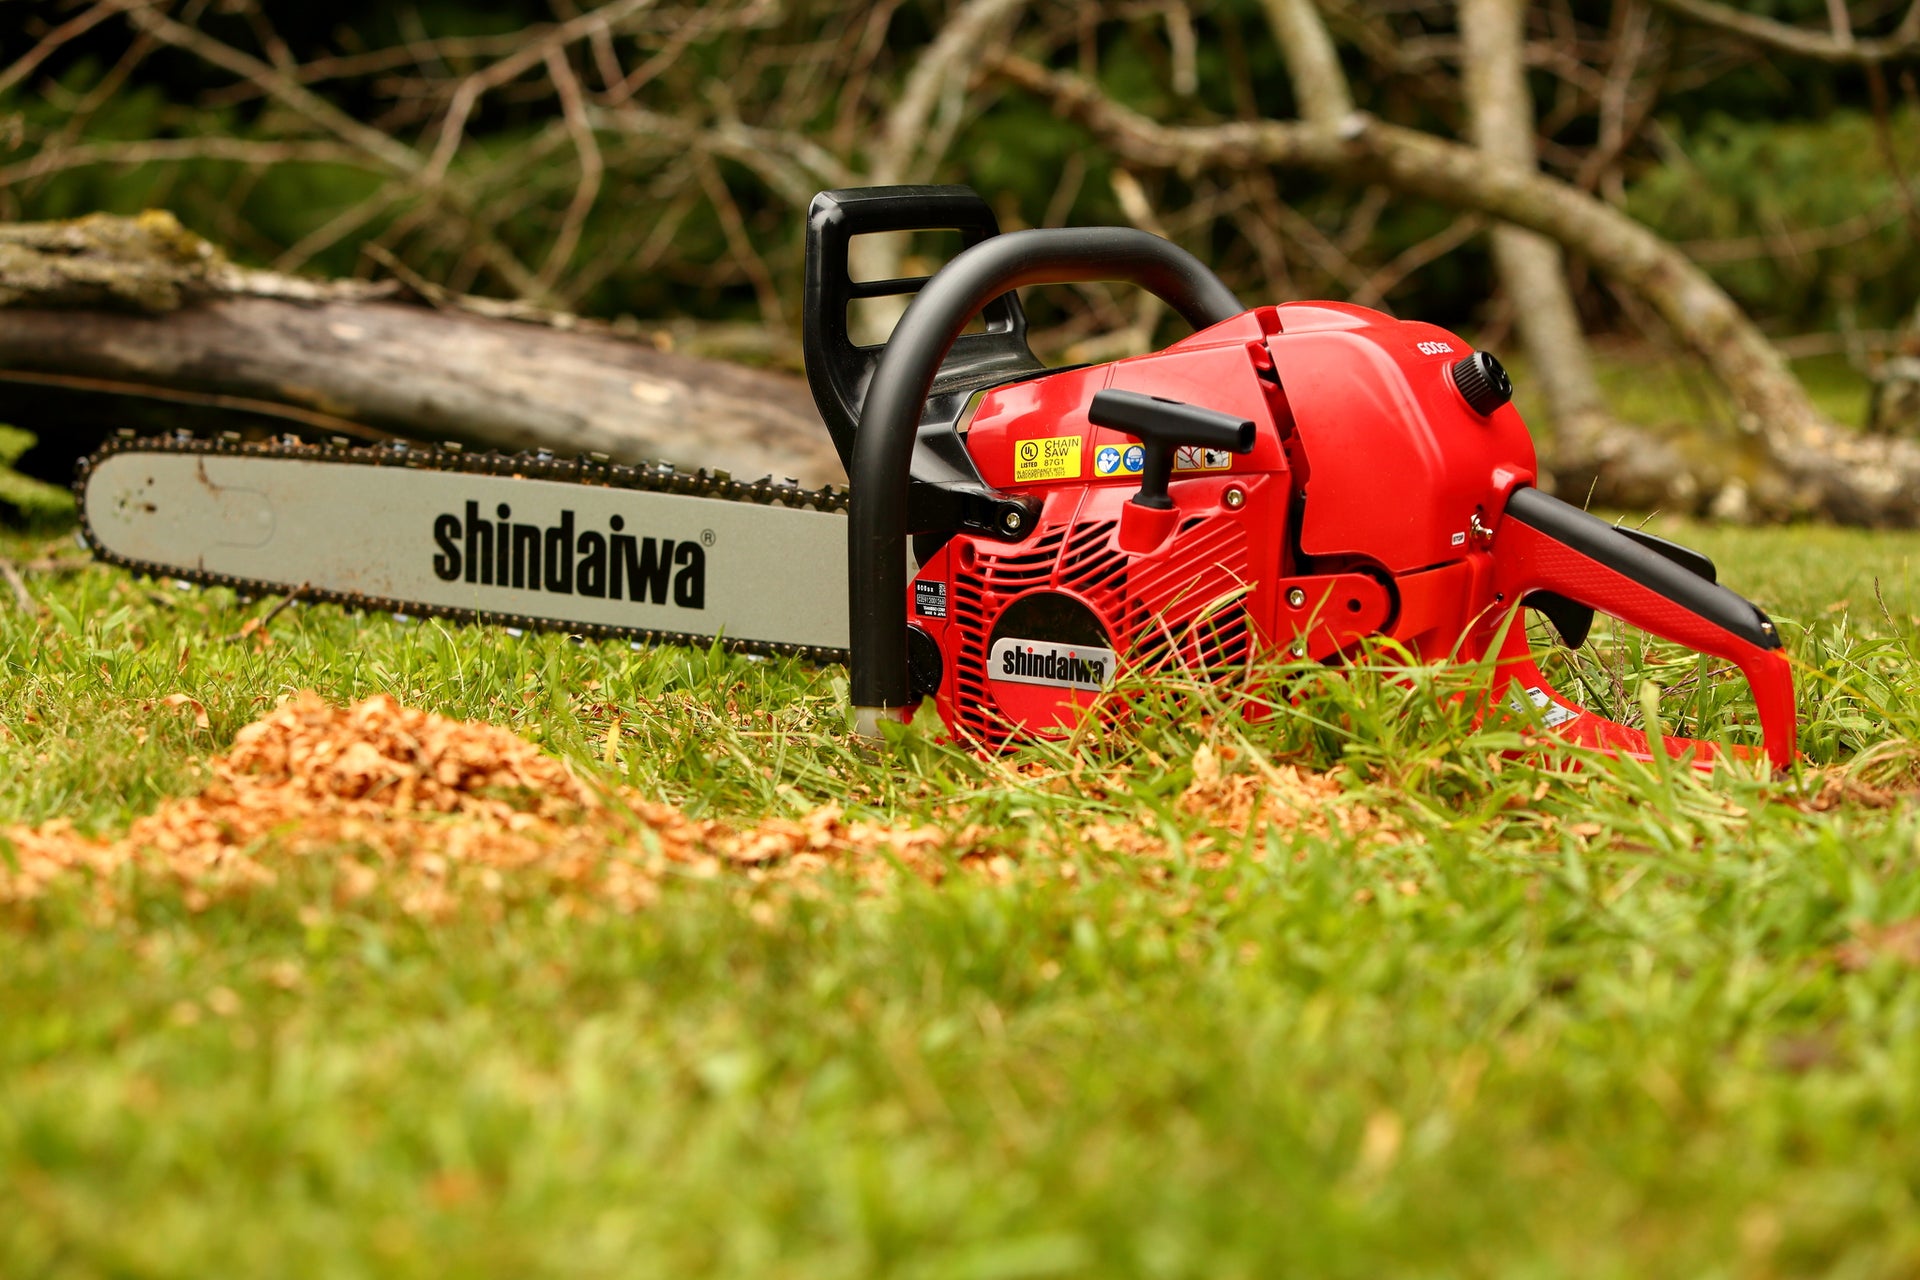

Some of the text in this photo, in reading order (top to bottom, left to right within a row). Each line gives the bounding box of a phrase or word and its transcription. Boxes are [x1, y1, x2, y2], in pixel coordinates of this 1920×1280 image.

[1044, 438, 1079, 449] CHAIN
[1044, 448, 1069, 458] SAW
[1044, 459, 1064, 467] 87G1
[433, 500, 705, 610] shindaiwa
[1002, 646, 1105, 684] shindaiwa
